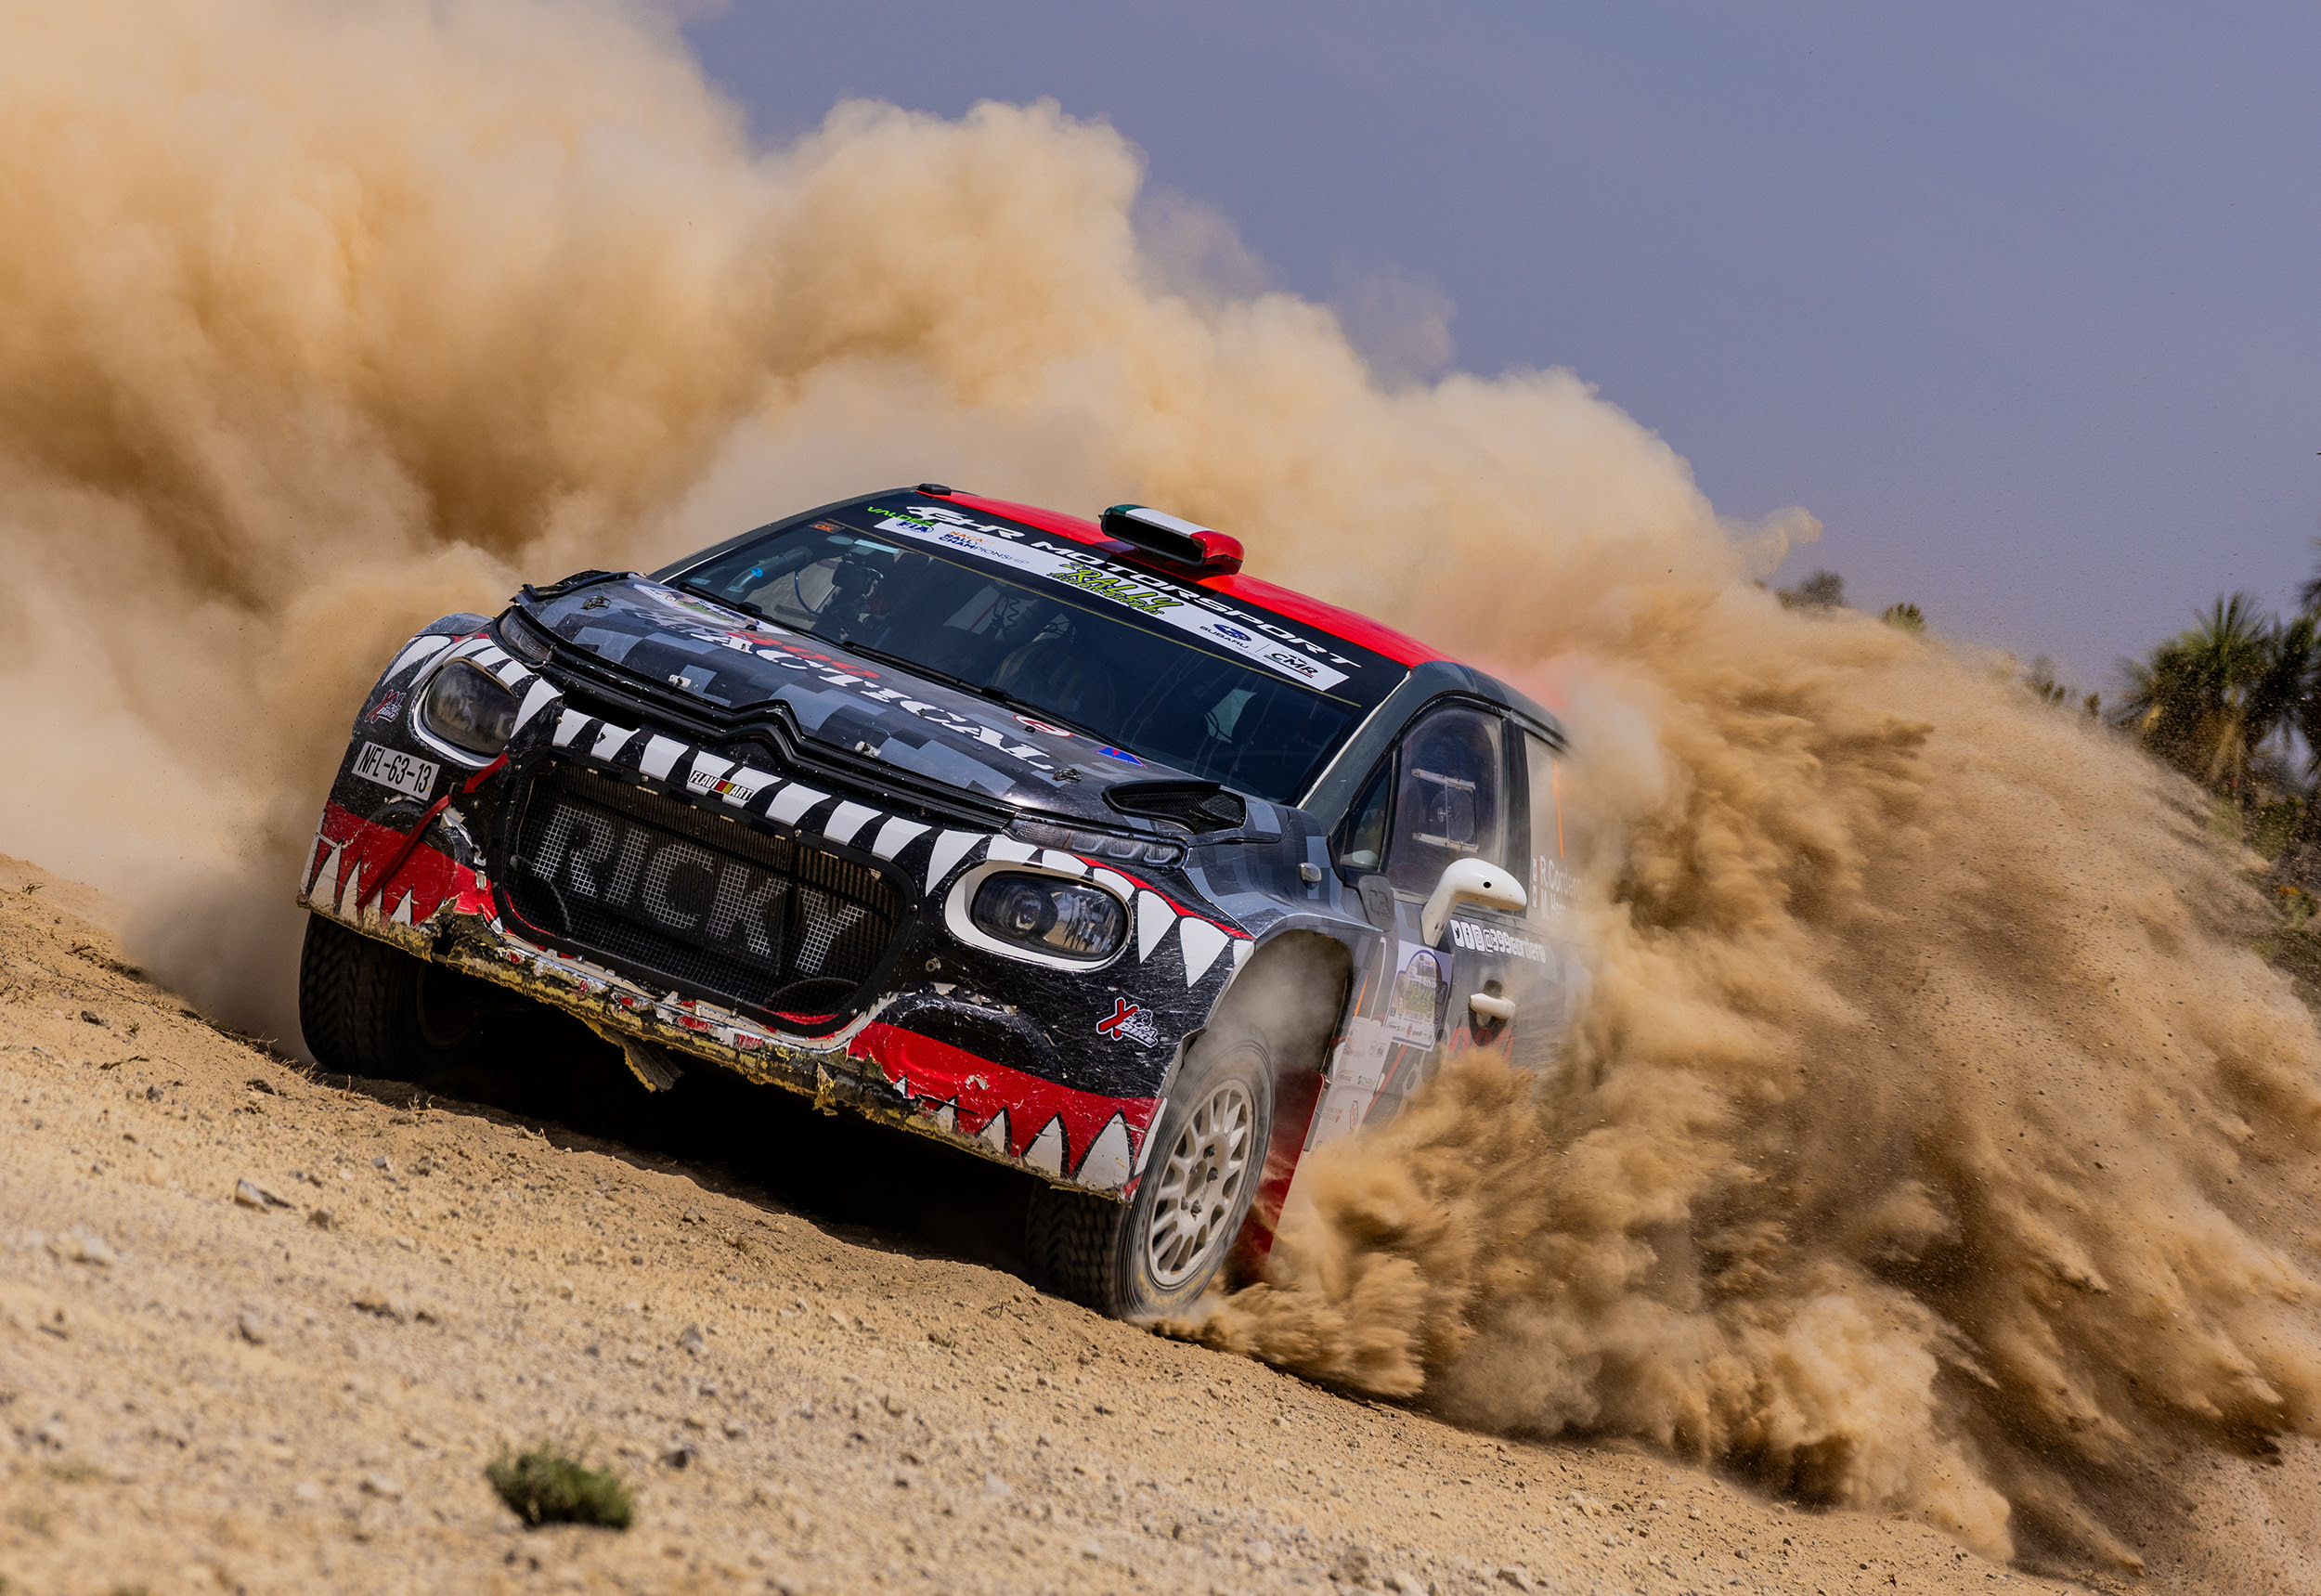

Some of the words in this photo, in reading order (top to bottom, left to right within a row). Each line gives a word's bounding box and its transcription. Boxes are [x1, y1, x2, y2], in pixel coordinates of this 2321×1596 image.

[867, 506, 935, 526] VALDEZ
[897, 520, 929, 534] FIA
[939, 536, 1030, 564] CHAMPIONSHIP
[942, 533, 978, 545] RALLY
[1066, 567, 1185, 610] RALLY
[1030, 541, 1362, 668] MOTORSPORT
[1199, 625, 1250, 650] SUBARU
[1270, 653, 1319, 674] CMR
[357, 744, 432, 794] NFL-63-13
[689, 771, 721, 789] FLAVI
[728, 785, 754, 799] ART
[532, 803, 867, 976] RICKY
